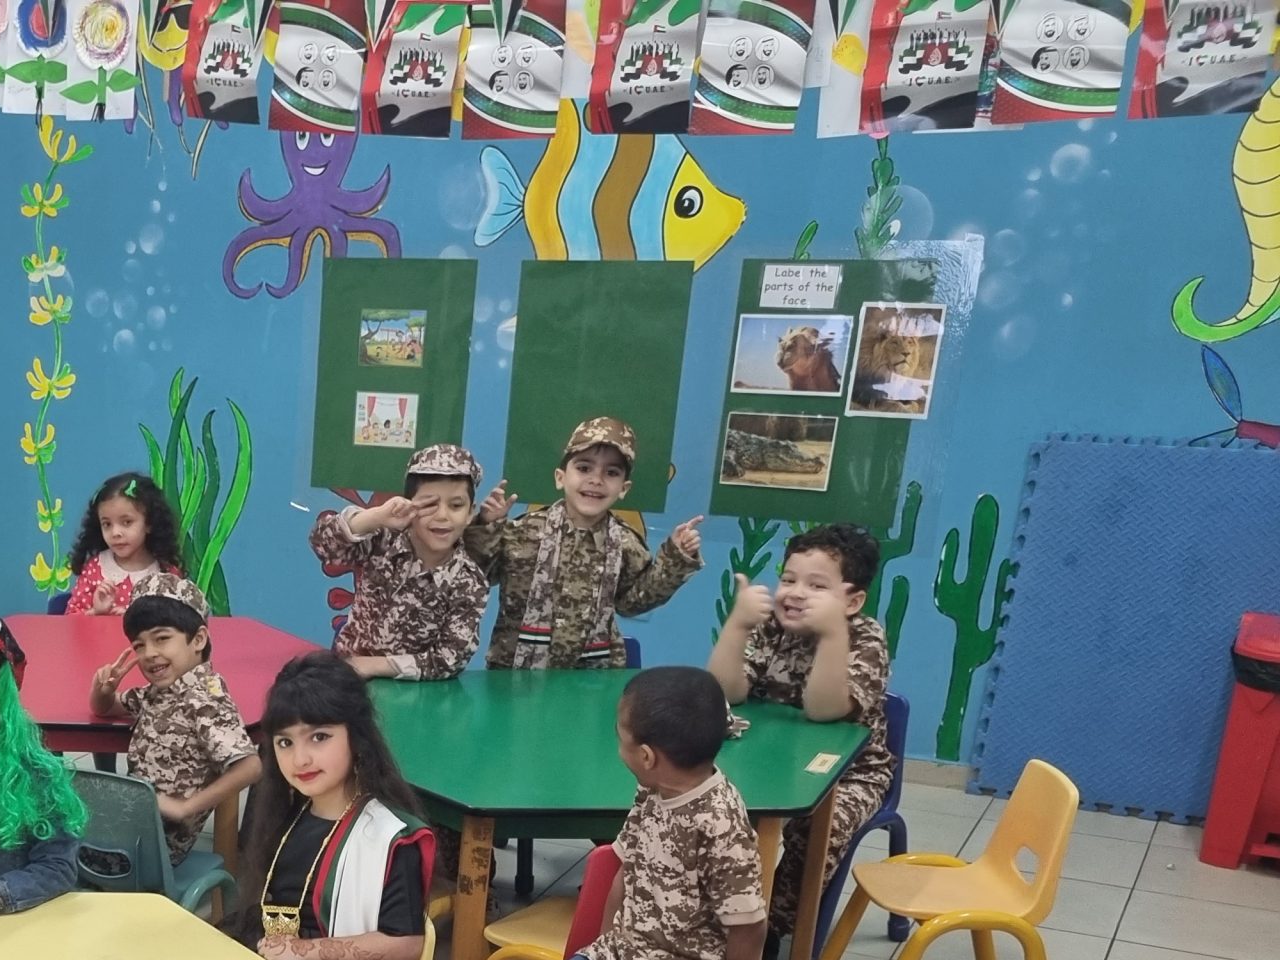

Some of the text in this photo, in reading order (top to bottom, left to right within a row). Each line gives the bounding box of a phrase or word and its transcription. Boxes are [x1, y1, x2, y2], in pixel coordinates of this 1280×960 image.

[774, 267, 827, 279] Labe the
[764, 282, 834, 294] parts of the
[782, 295, 807, 306] face
